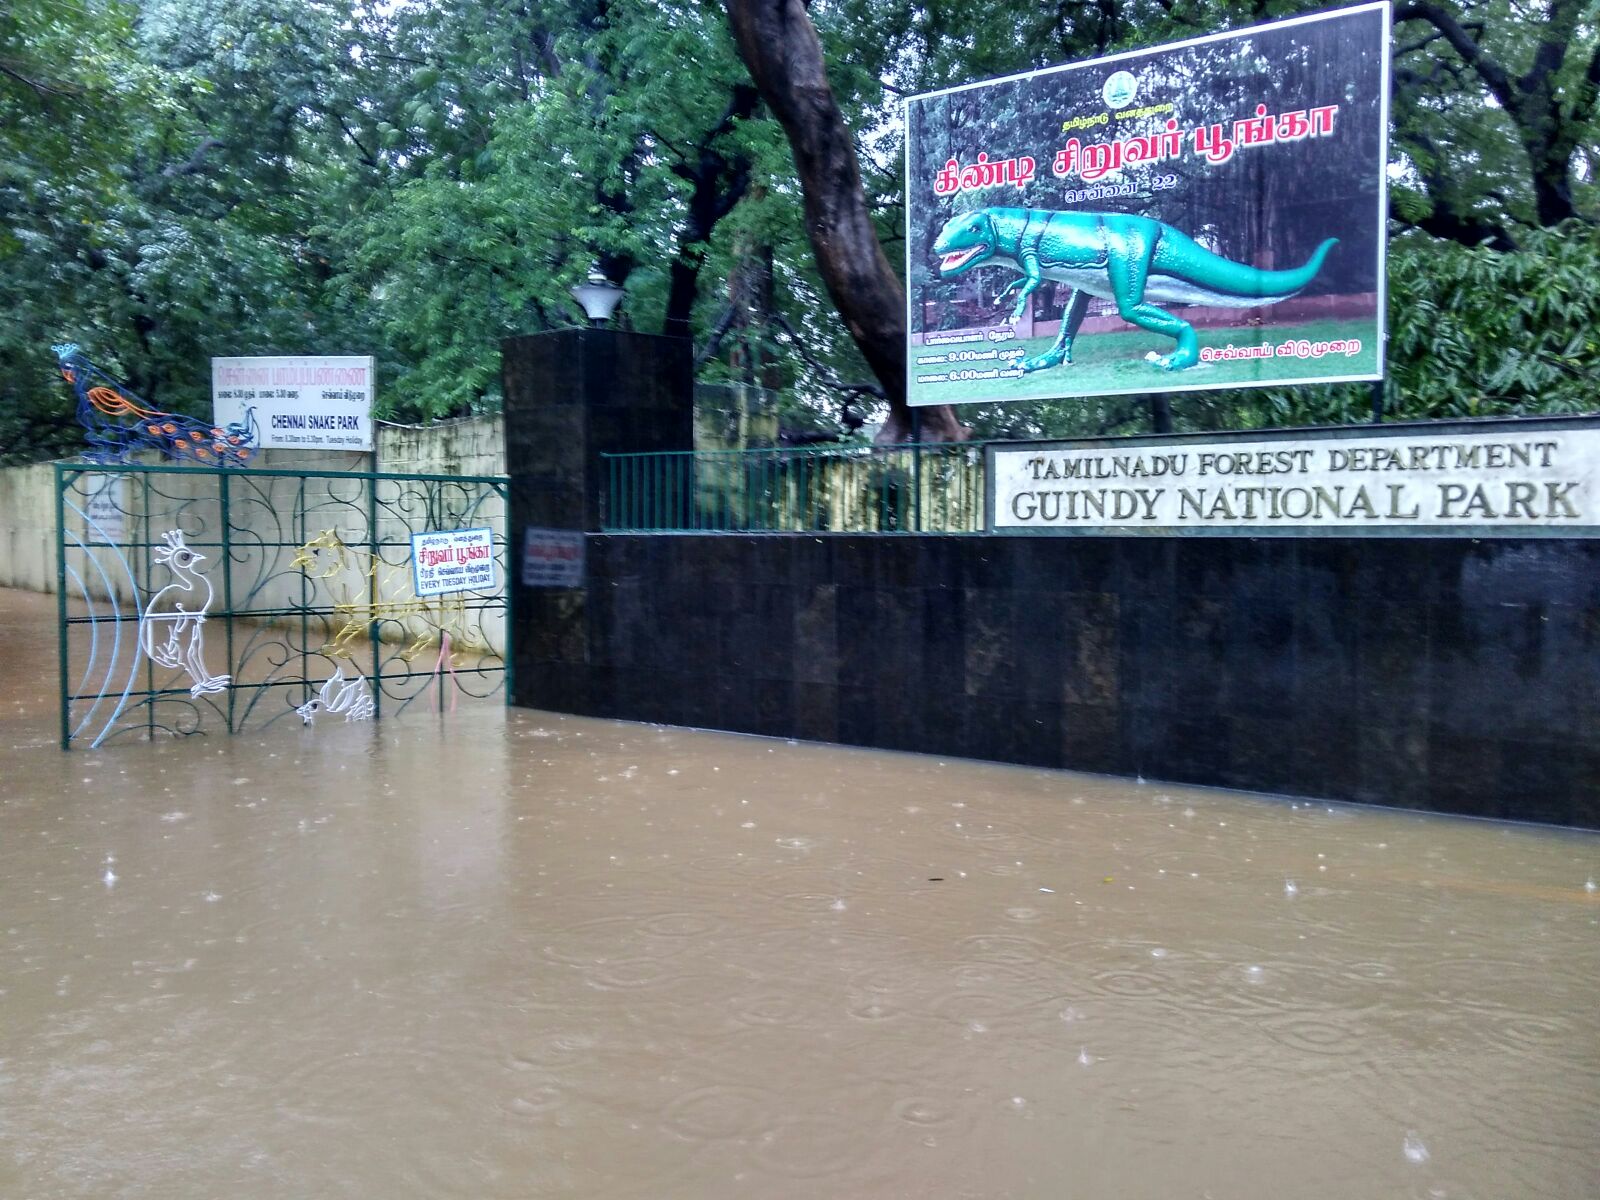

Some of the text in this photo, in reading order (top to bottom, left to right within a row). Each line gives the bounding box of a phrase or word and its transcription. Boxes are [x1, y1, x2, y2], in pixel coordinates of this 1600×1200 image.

[1062, 102, 1174, 132] தமிழ்நாடு வனத்துறை
[933, 103, 1339, 196] கிண்டி சிறுவர் பூங்கா
[1064, 182, 1138, 203] சென்னை
[1151, 174, 1177, 191] 22
[988, 328, 1015, 343] நேரம்
[998, 346, 1025, 361] முதல்
[1200, 339, 1361, 361] செவ்வாய் விடுமுறை
[271, 414, 359, 430] CHENNAI SNAKE PARK
[326, 435, 345, 445] Tuesday
[345, 435, 363, 446] Holiday
[1029, 442, 1558, 480] TAMILNADU FOREST DEPARTMENT
[1011, 481, 1580, 521] GUINDY NATIONAL PARK
[419, 543, 490, 566] சிறுவர் பூங்கா
[421, 574, 490, 589] EVERY TUESDAY HOLIDAY
